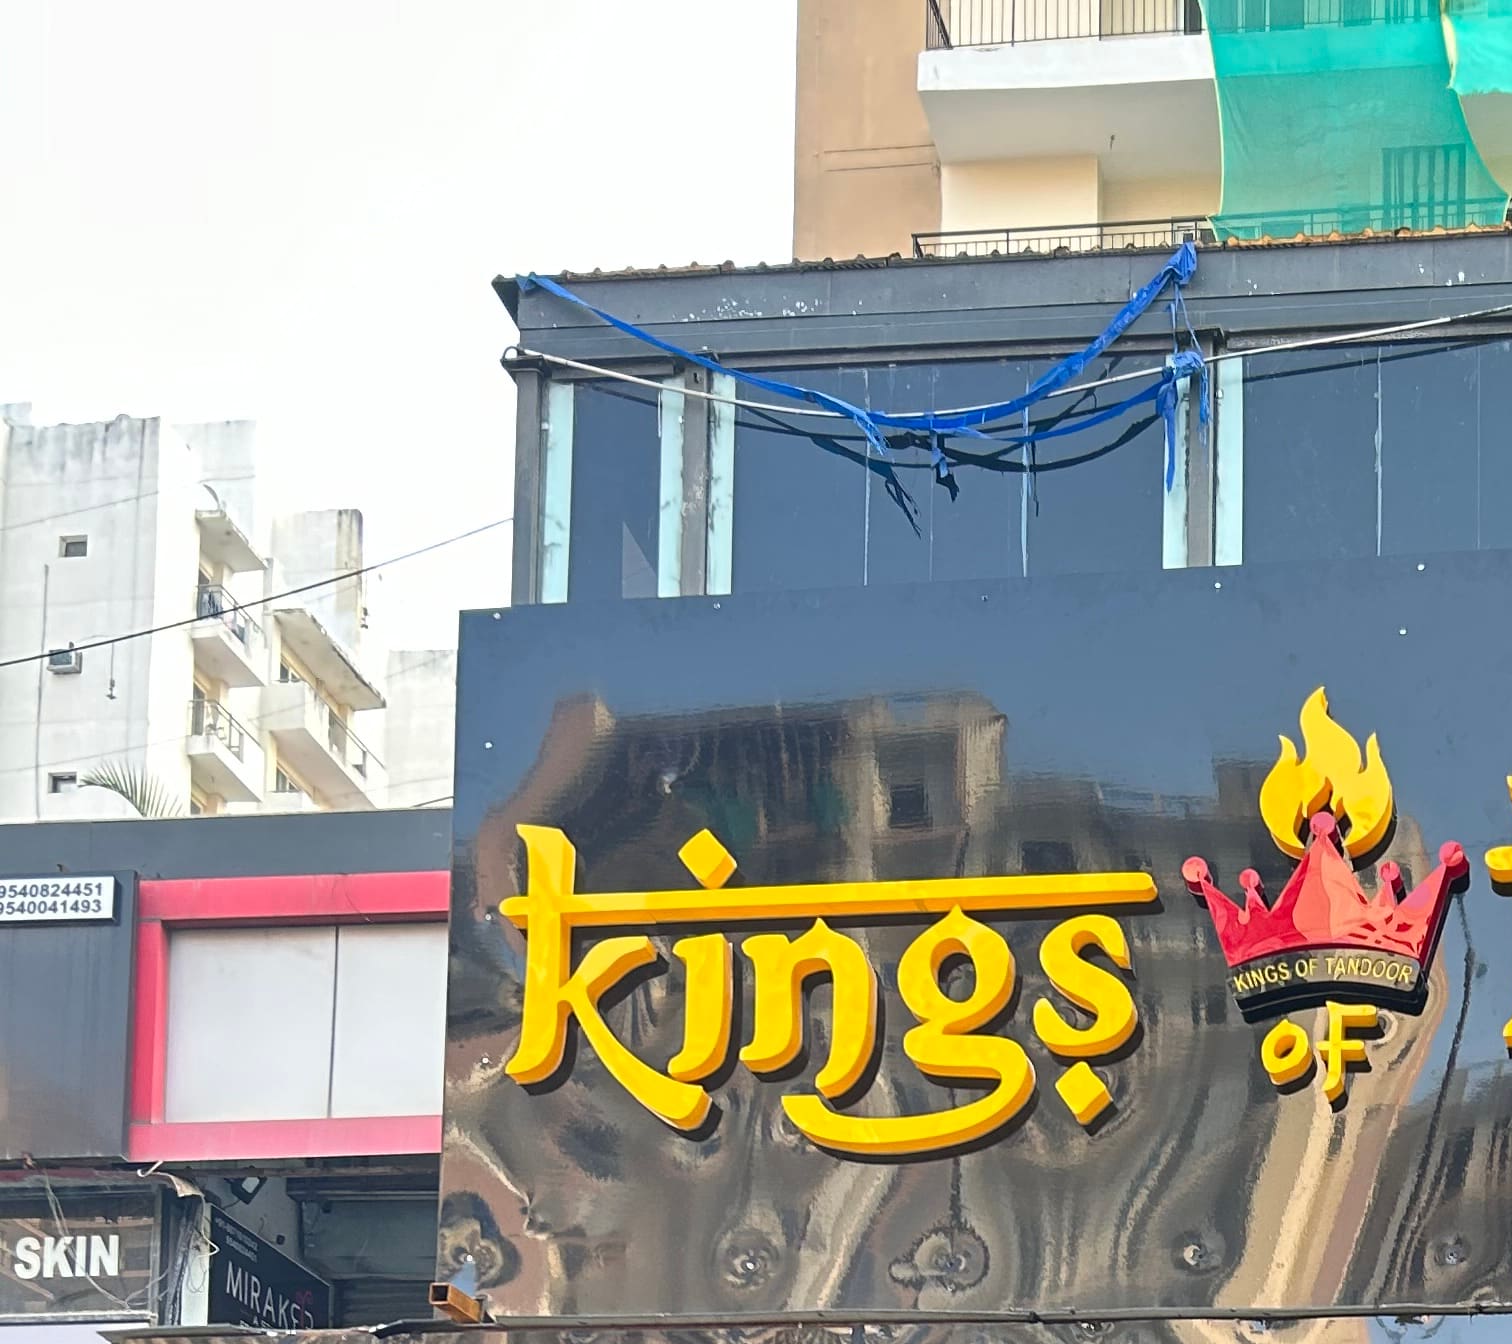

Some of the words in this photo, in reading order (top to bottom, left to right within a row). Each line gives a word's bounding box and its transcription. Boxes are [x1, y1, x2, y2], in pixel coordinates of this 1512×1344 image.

[0, 882, 103, 899] 9540824451
[1234, 961, 1290, 993] KINGS
[1294, 957, 1319, 977] OF
[1324, 956, 1414, 984] TANDOOR
[14, 1234, 120, 1279] SKIN
